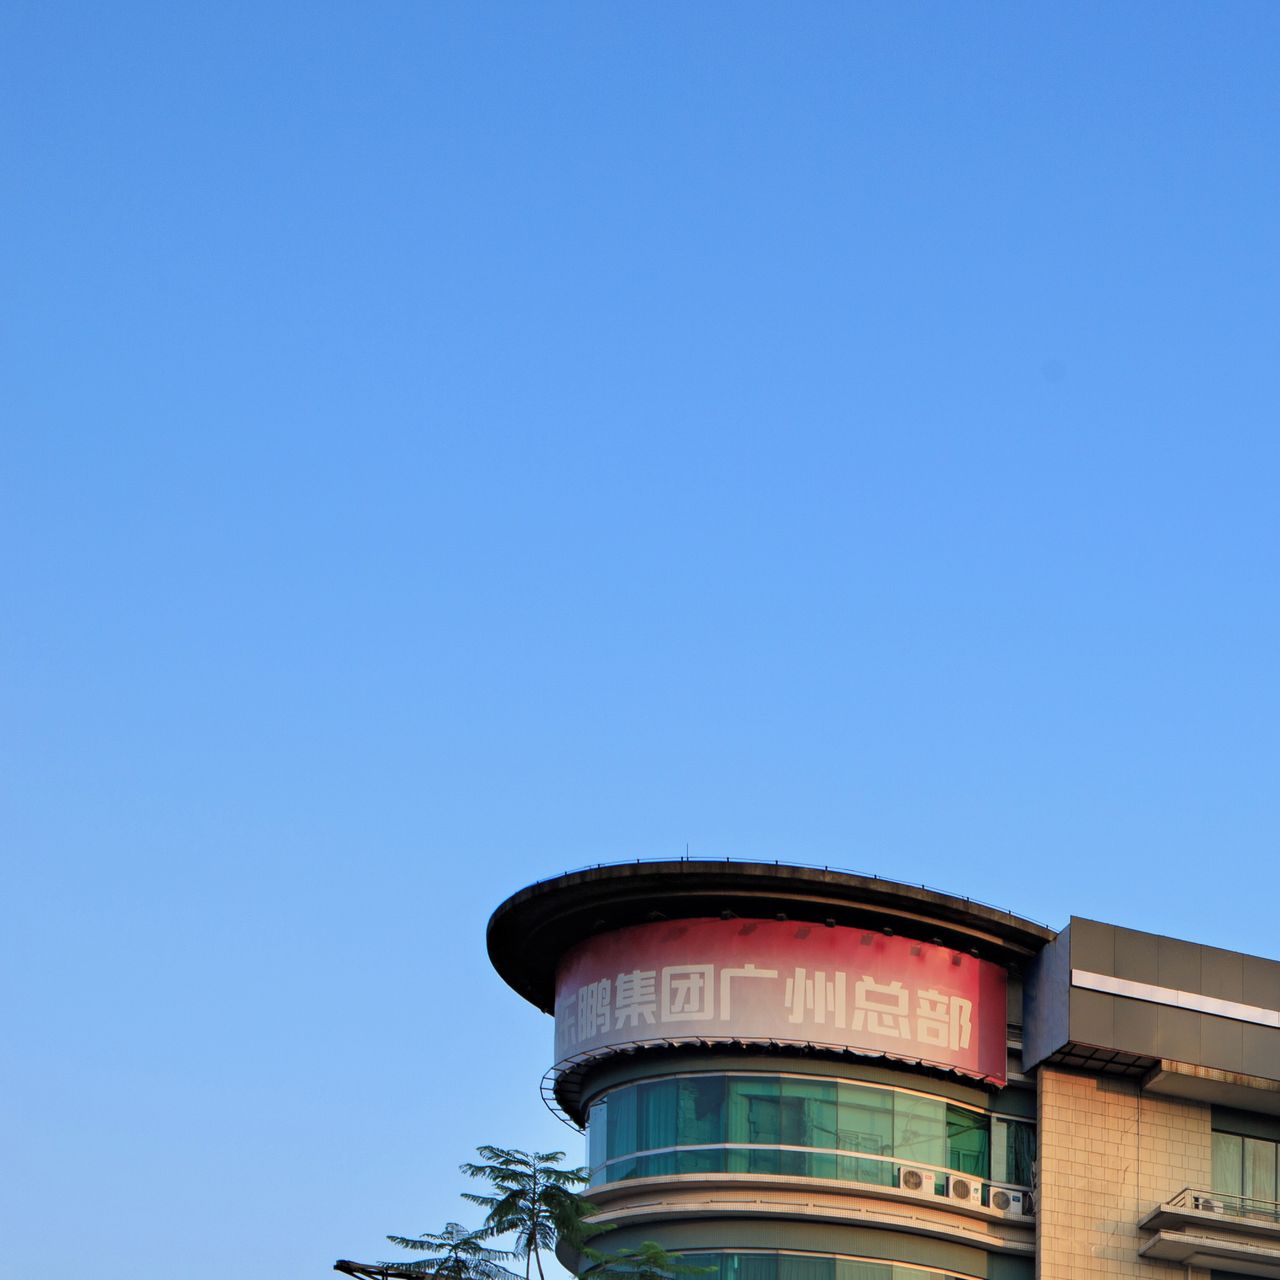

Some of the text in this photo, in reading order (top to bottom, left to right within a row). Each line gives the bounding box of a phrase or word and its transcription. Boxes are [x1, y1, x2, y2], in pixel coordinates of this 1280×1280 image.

[558, 963, 973, 1051] 东鹏集团广州总部
